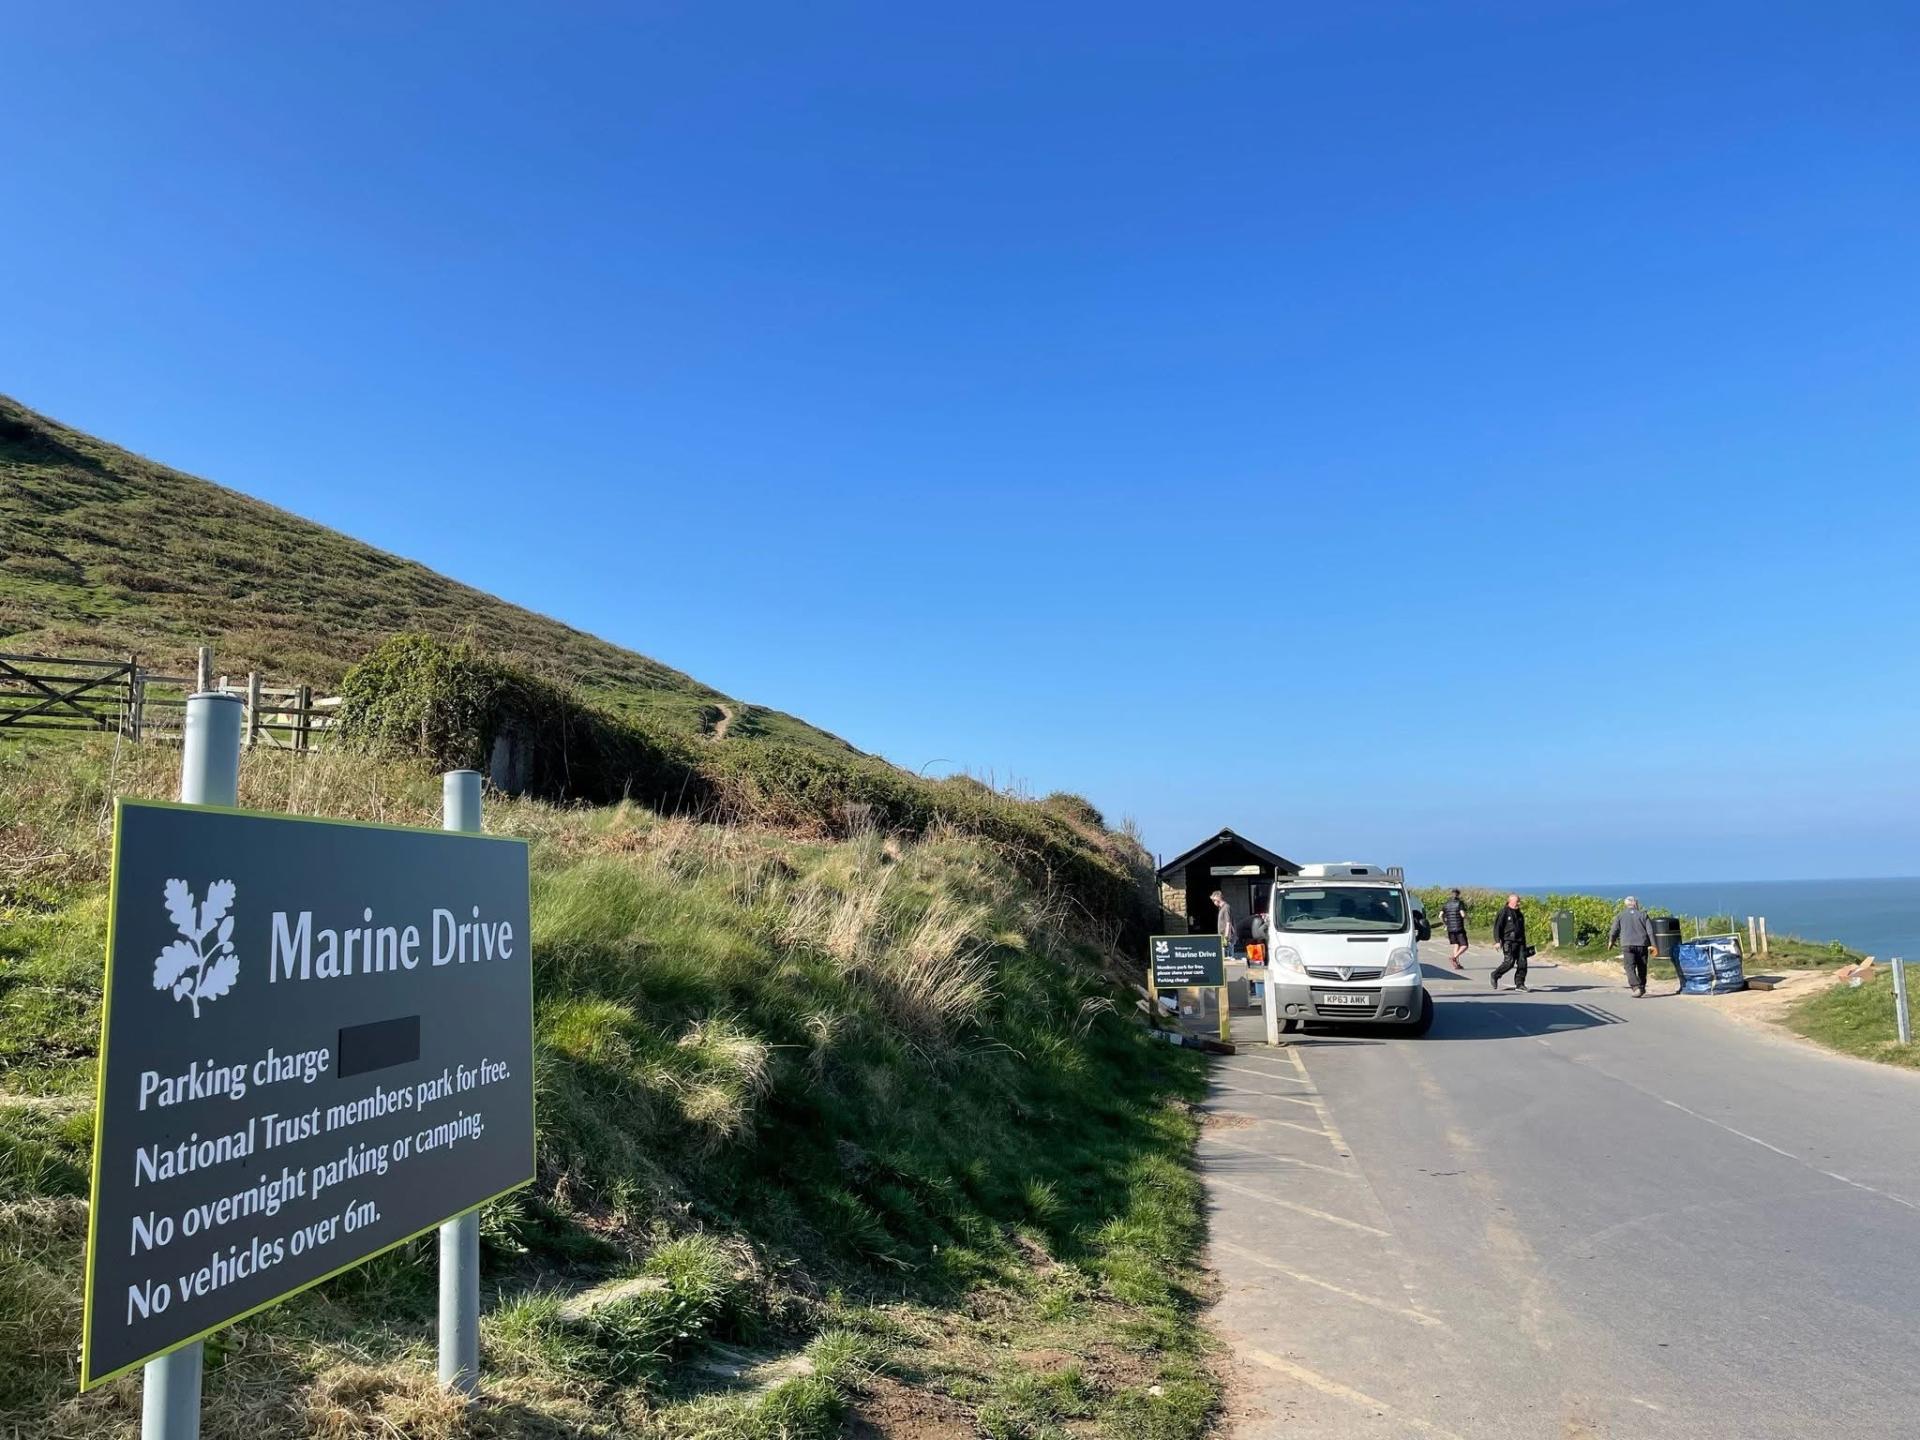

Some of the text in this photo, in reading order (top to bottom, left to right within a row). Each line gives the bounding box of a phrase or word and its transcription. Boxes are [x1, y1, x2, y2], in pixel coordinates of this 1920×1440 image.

[269, 905, 513, 984] Marine Drive
[1327, 996, 1348, 1004] KP63
[134, 1057, 511, 1187] National Trust members park for free.
[139, 1047, 330, 1112] Parking charge
[130, 1109, 485, 1256] No overnight parking or camping.
[127, 1198, 381, 1326] No vehicles over 6m.
